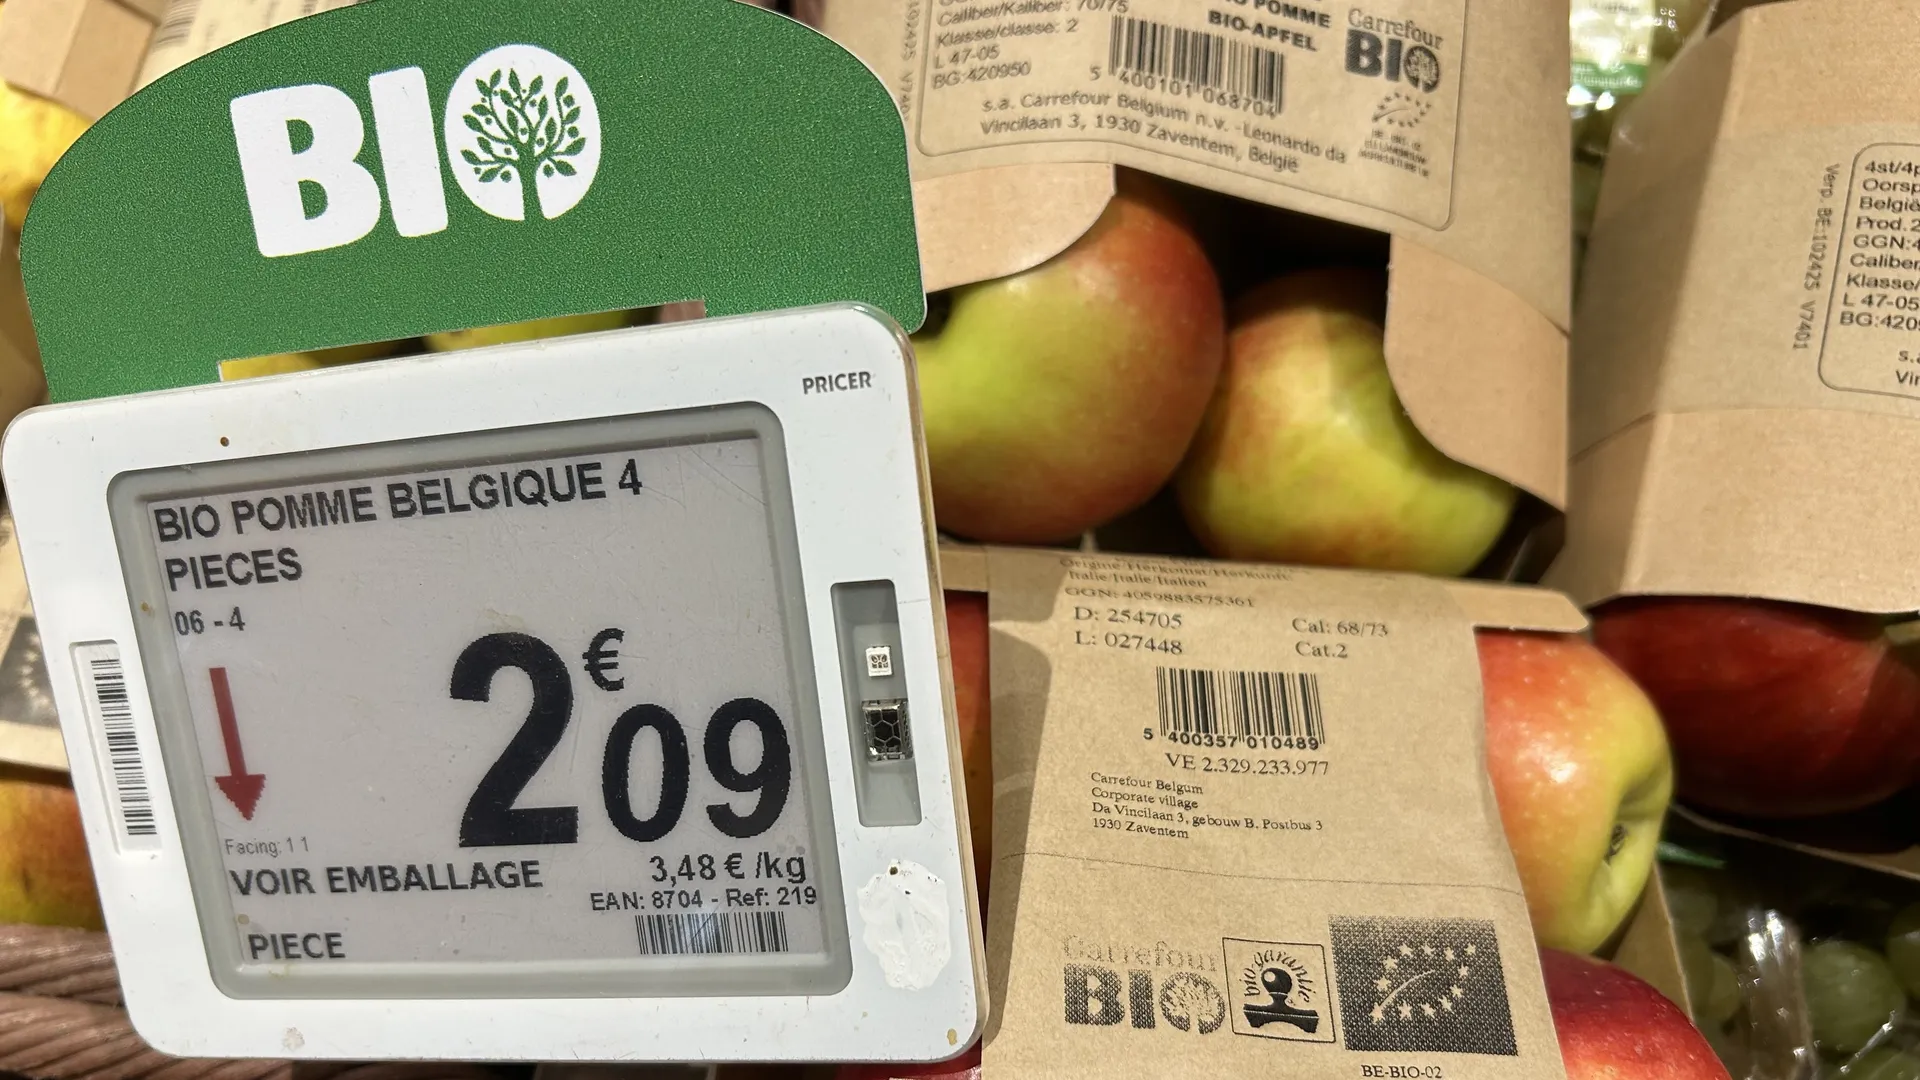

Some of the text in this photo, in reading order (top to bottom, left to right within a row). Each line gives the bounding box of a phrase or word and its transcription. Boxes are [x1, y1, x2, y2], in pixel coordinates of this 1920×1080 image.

[1066, 18, 1079, 33] 2
[1254, 0, 1331, 28] POMME
[1208, 10, 1317, 52] BIO-APFEL
[1348, 8, 1443, 50] Carrefour
[934, 45, 1000, 69] L 47-05
[1345, 29, 1440, 93] BIO
[1090, 66, 1277, 119] 5 400101 068704
[982, 100, 1015, 113] s.a.
[1020, 90, 1110, 109] Carrefour
[1117, 93, 1189, 122] Belgium
[1325, 144, 1346, 164] da
[230, 43, 602, 258] BIO
[1067, 115, 1086, 132] 3,
[1096, 115, 1141, 134] 1930
[1147, 124, 1242, 162] Zaventem,
[1248, 143, 1299, 174] België
[1843, 292, 1920, 311] L 47-05
[1840, 311, 1920, 331] BG:420
[802, 371, 873, 394] PRICER
[154, 458, 643, 542] BIO POMME BELGIQUE 4
[165, 548, 303, 592] PIECES
[1065, 586, 1117, 599] GGN:
[175, 610, 205, 636] 06
[229, 606, 246, 632] 4
[1073, 606, 1183, 630] D: 254705
[1292, 617, 1389, 639] Cal: 68/73
[1074, 630, 1184, 656] L: 027448
[1295, 640, 1348, 660] Cat.2
[450, 628, 791, 848] 2 € 09
[1143, 728, 1319, 751] 5 400357 010489
[1165, 752, 1330, 776] VE 2.329.233.977
[1090, 771, 1203, 796] Carrefour Belgum
[1091, 786, 1199, 811] Corporate village
[1092, 801, 1323, 831] Da Vincilaan 3, gebouw B. Postbus 3
[1093, 817, 1190, 840] 1930 Zaventem
[224, 837, 282, 858] Facing:
[228, 860, 543, 896] VOIR EMBALLAGE
[650, 852, 806, 887] 3,48 € /kg
[590, 891, 645, 911] EAN:
[651, 890, 703, 909] 8704
[725, 887, 769, 907] Ref:
[777, 886, 817, 906] 219
[248, 932, 346, 960] PIECE
[1064, 935, 1220, 972] Carrefour
[1064, 963, 1226, 1035] BIO
[1360, 1064, 1443, 1079] BE-BIO-02
